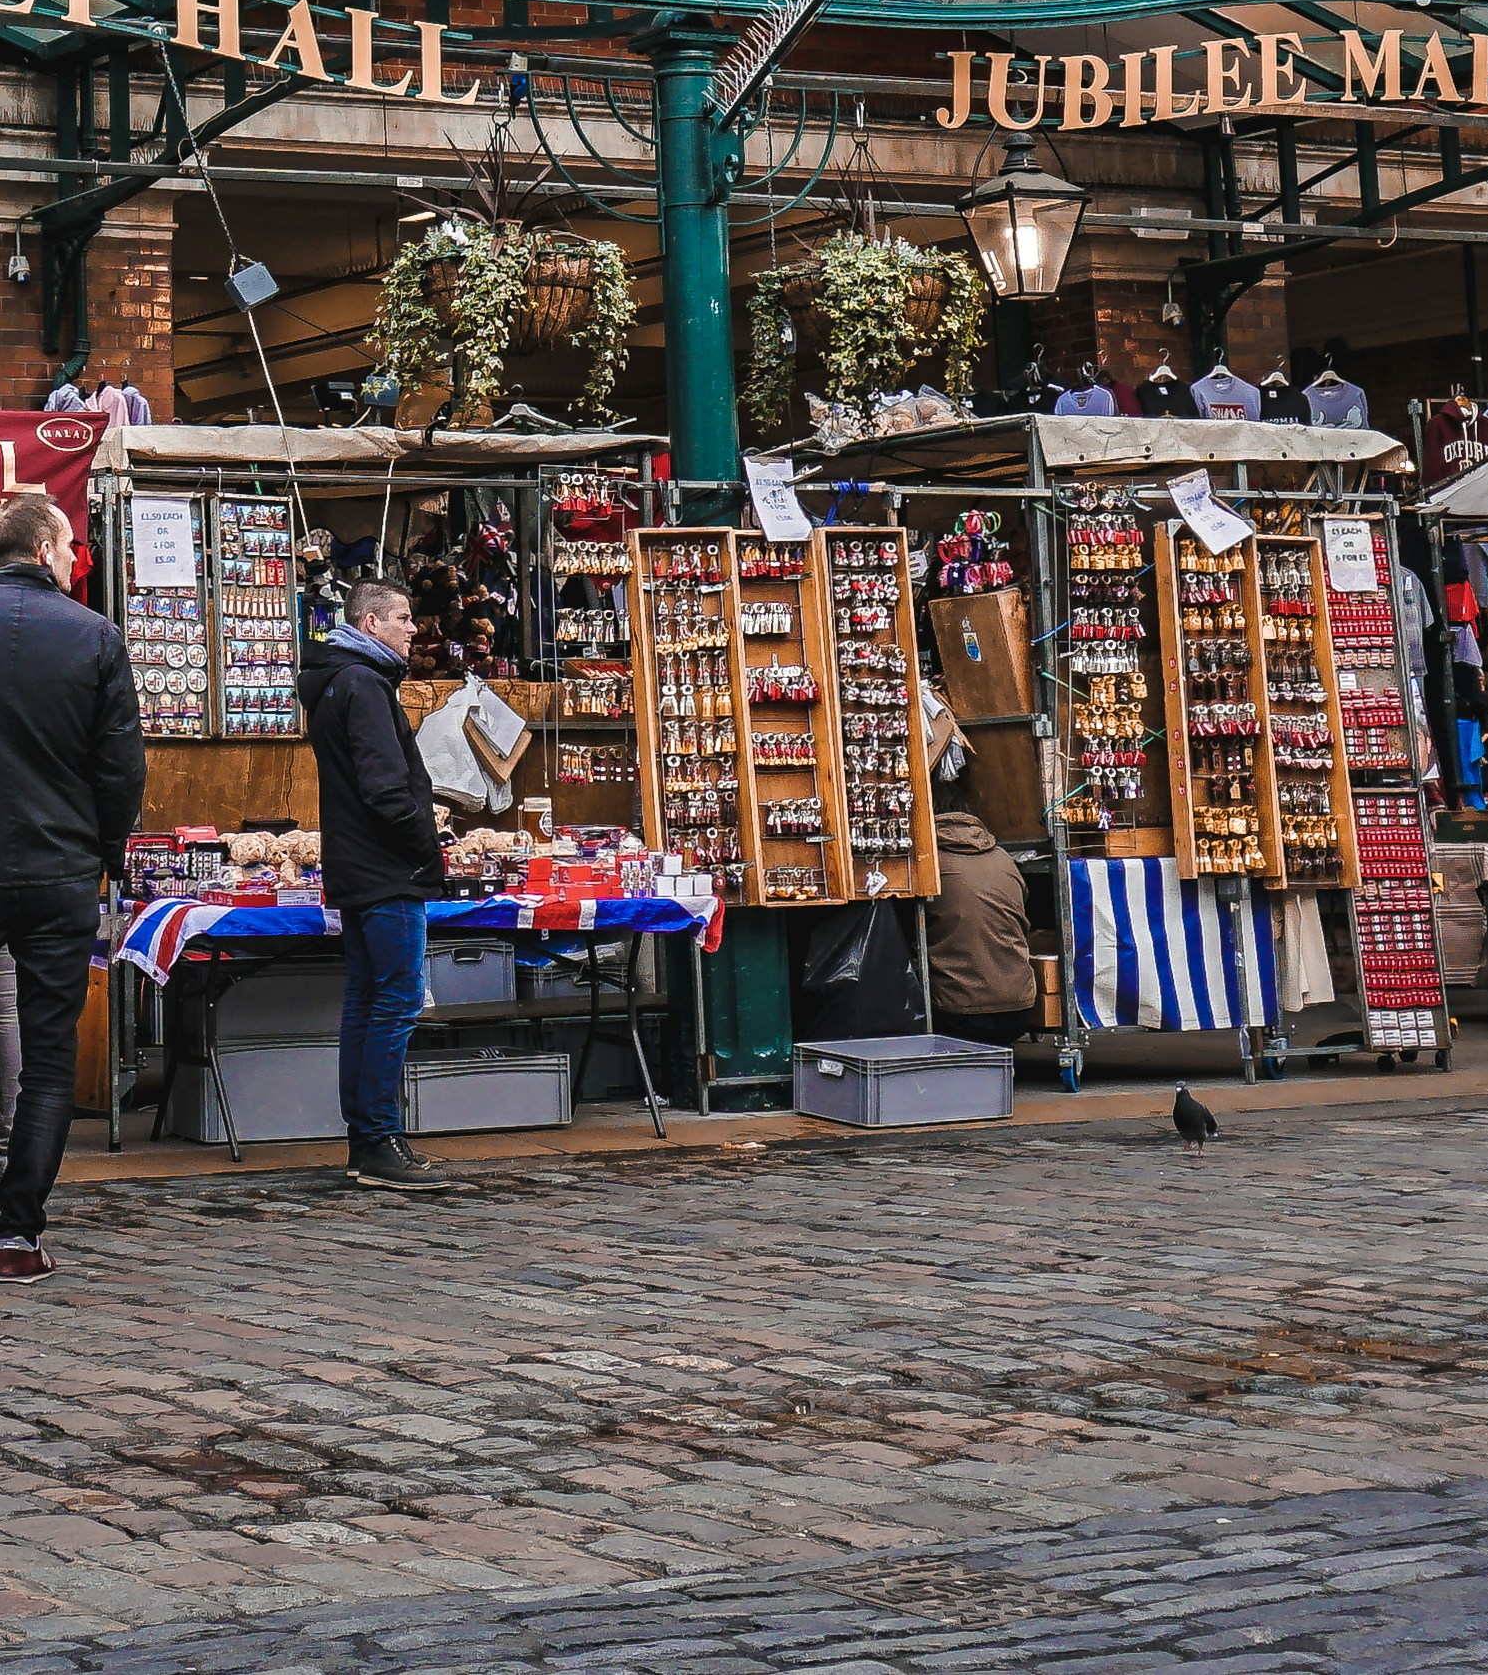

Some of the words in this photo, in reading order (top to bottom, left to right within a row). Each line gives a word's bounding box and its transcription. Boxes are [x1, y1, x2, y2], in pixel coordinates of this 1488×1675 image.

[935, 30, 1310, 132] JUBILEE
[42, 428, 89, 440] HALAL
[163, 512, 183, 521] EACH
[157, 527, 168, 535] OR
[1342, 527, 1362, 535] EACH
[160, 542, 175, 550] FOR
[1342, 554, 1358, 562] FOR
